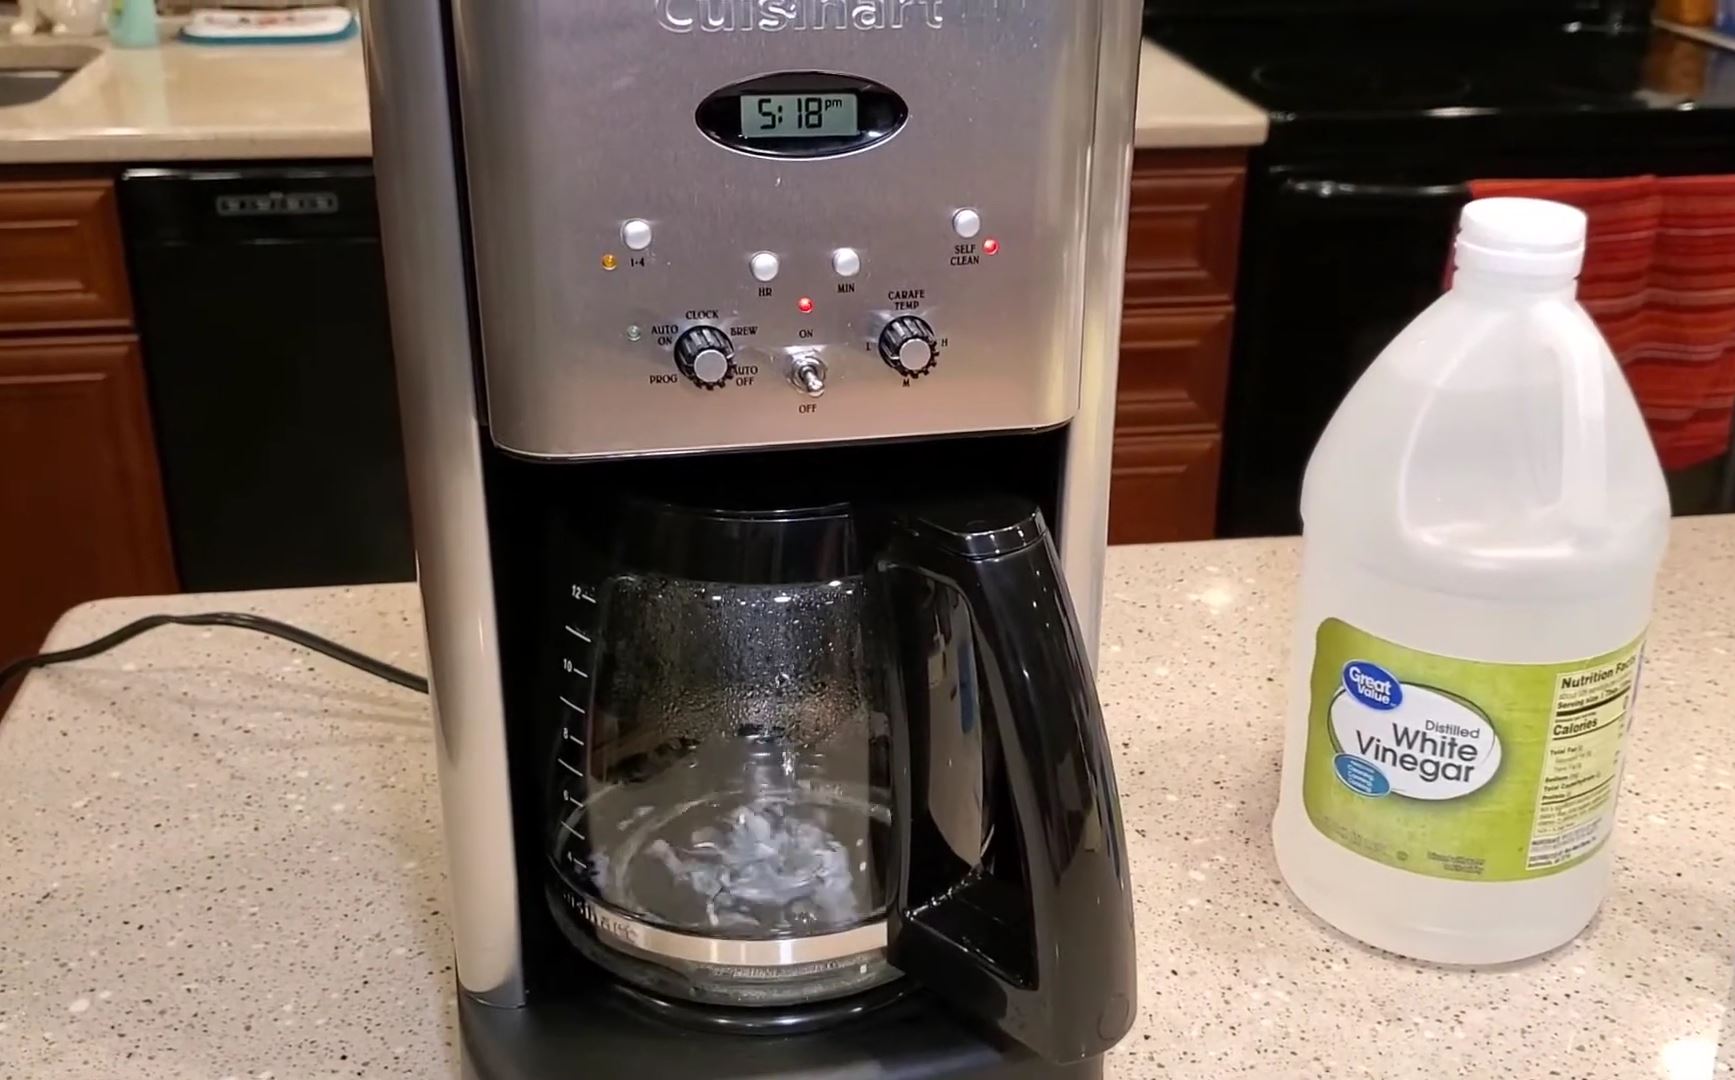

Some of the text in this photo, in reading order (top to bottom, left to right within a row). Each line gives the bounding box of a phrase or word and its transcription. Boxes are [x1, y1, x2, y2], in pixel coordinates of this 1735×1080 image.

[656, 0, 944, 33] Cuisinart
[758, 97, 822, 130] 5:18
[954, 244, 976, 254] SELF
[950, 256, 980, 266] CLEAN
[758, 287, 772, 297] HR
[837, 283, 855, 293] MIN
[888, 289, 925, 301] CARAFE
[895, 301, 919, 310] TEMP
[685, 310, 719, 320] CLOCK
[651, 324, 679, 335] AUTO
[730, 326, 758, 337] BREW
[799, 329, 813, 339] ON
[657, 335, 672, 346] ON
[733, 365, 758, 376] AUTO
[649, 374, 678, 385] PROG
[736, 375, 754, 387] OFF
[798, 403, 817, 414] OFF
[572, 584, 582, 599] 12
[563, 658, 573, 673] 10
[1349, 666, 1392, 696] Great
[1561, 668, 1614, 689] Nutrition
[1357, 682, 1390, 705] Value
[1425, 719, 1480, 739] Distilled
[1553, 718, 1597, 735] Calories
[1392, 722, 1478, 762] White
[1356, 729, 1475, 782] Vinegar
